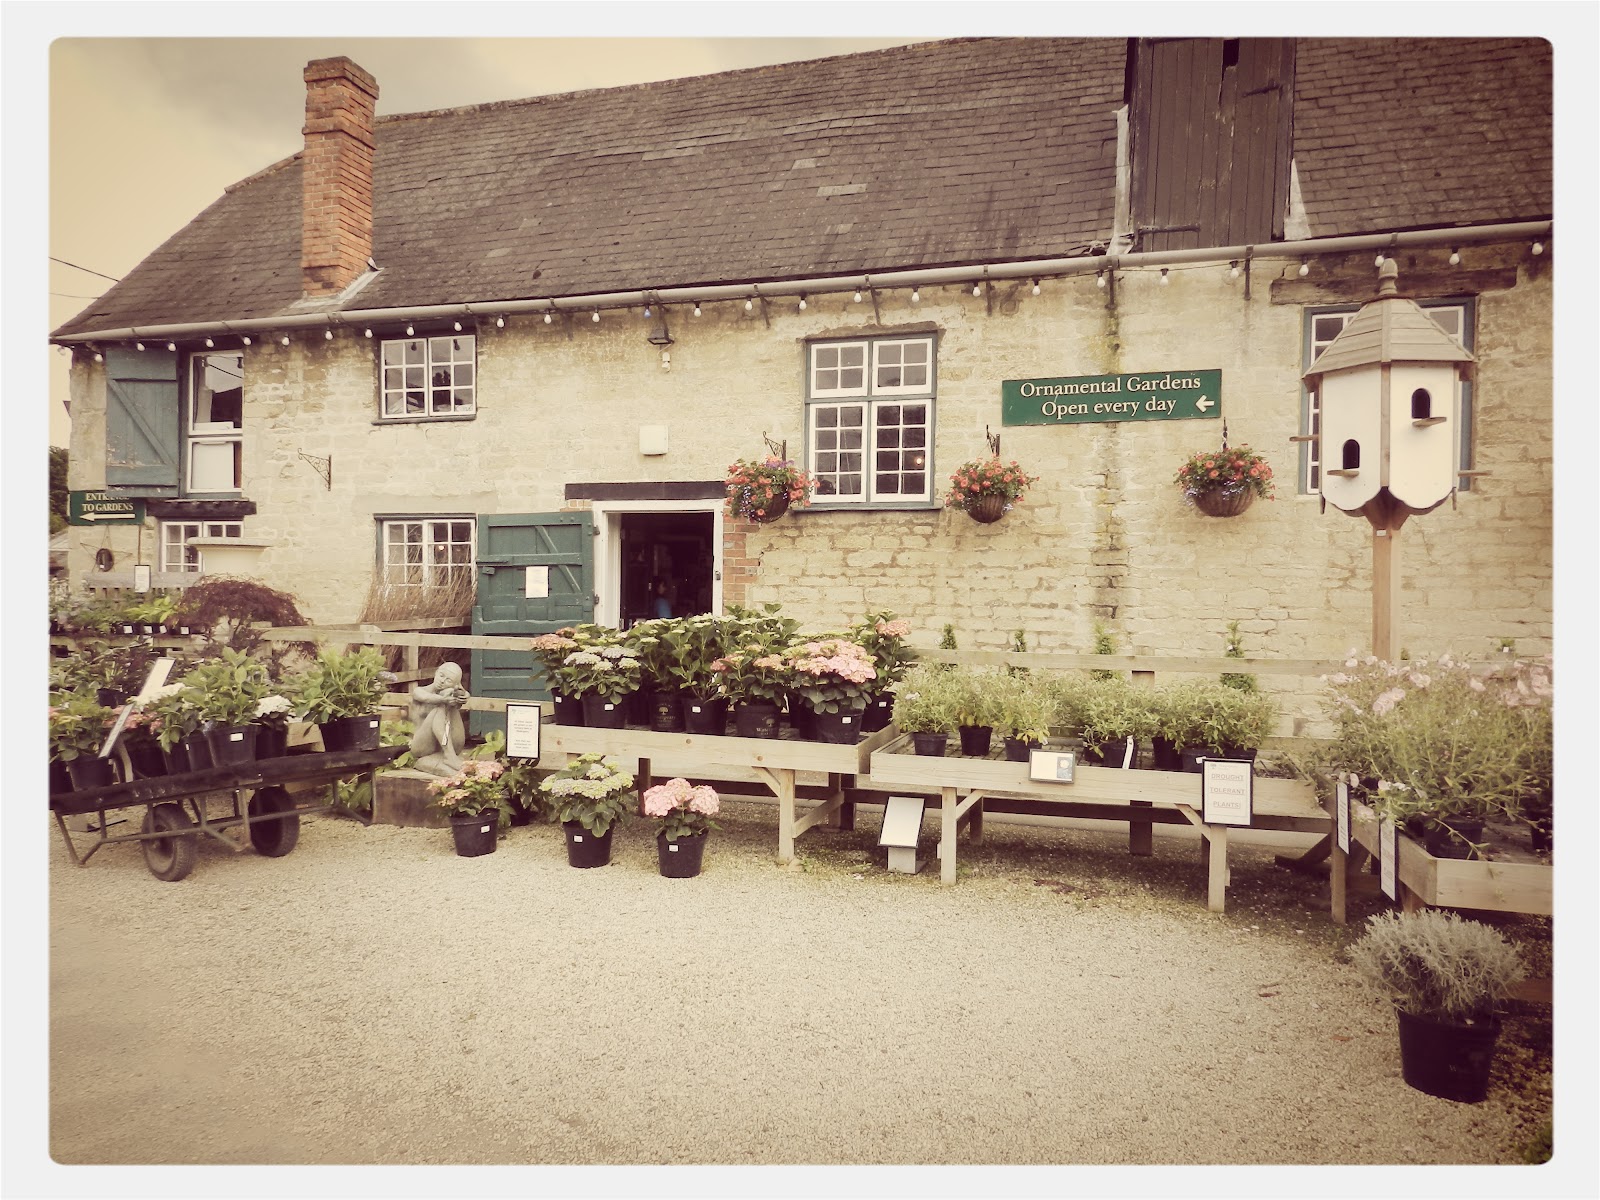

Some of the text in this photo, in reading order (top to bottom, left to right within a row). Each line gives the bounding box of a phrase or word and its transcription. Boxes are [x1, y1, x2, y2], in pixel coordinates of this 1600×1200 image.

[1020, 375, 1201, 398] Ornamental Gardens
[1041, 396, 1177, 419] Open every day
[82, 503, 134, 511] TO GARDENS
[1210, 787, 1245, 795] TOLERANT
